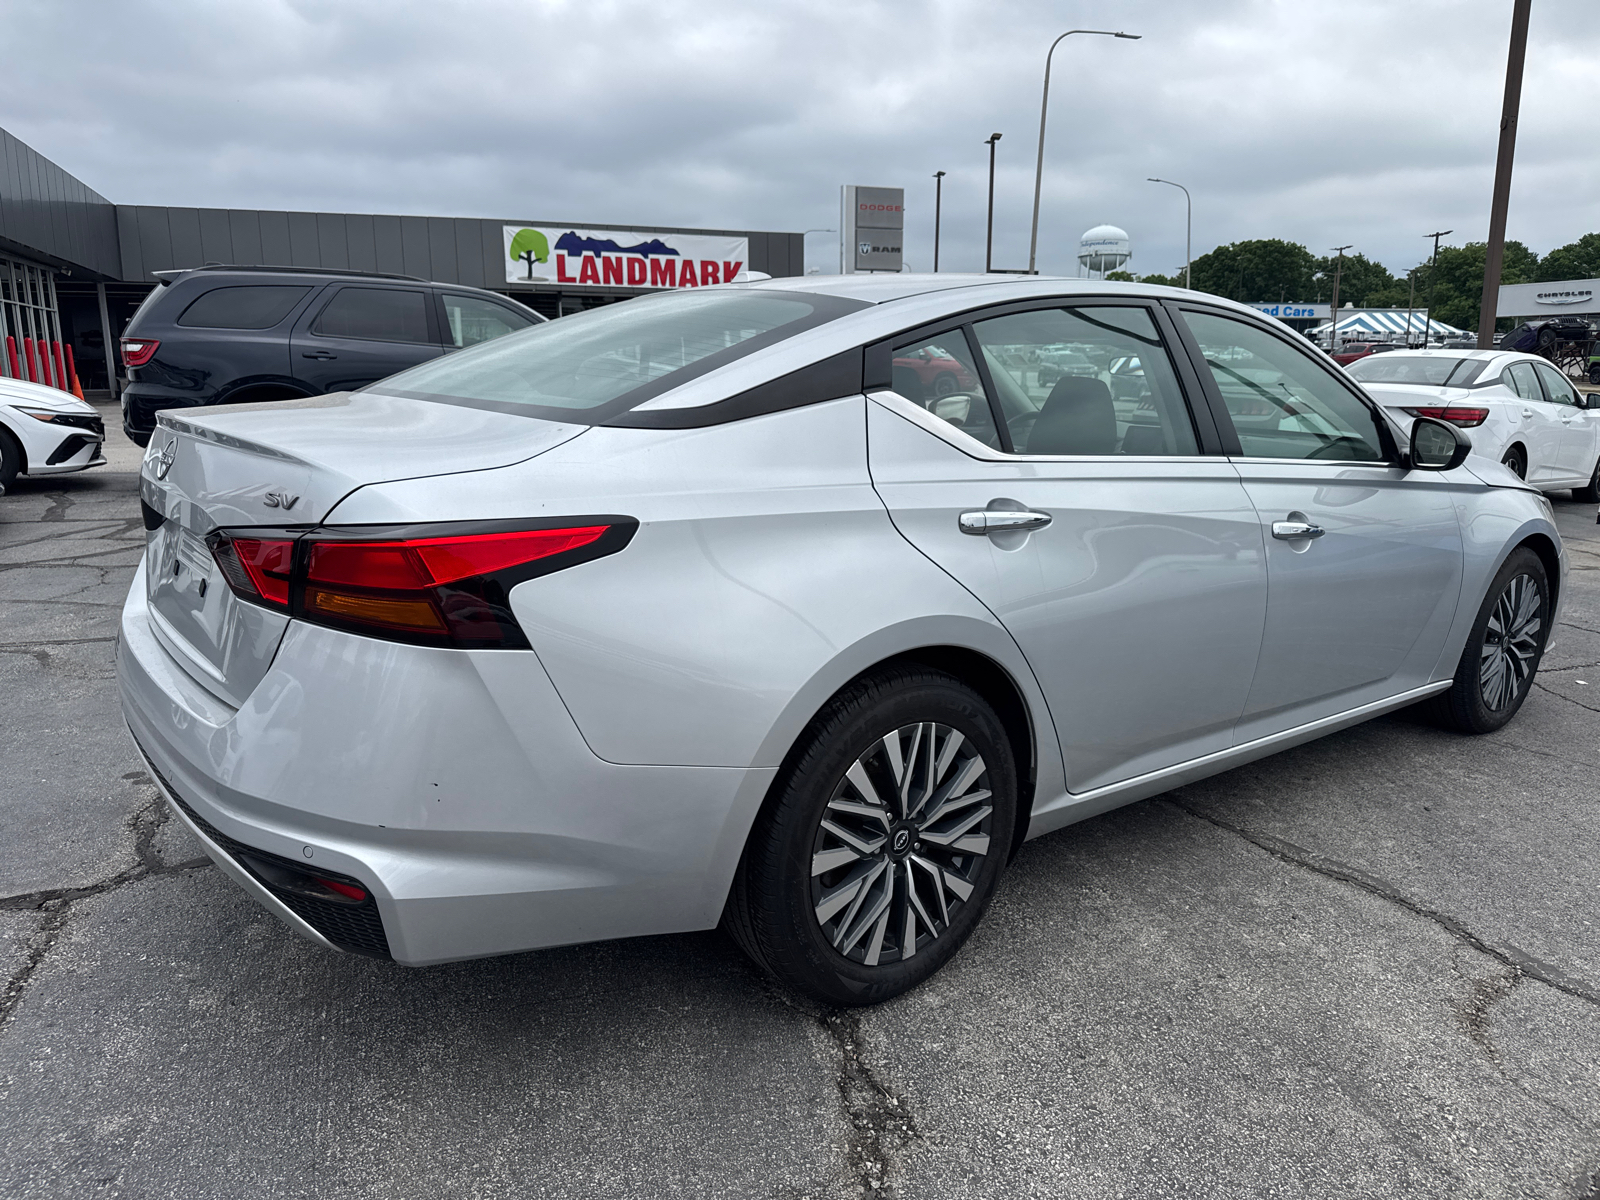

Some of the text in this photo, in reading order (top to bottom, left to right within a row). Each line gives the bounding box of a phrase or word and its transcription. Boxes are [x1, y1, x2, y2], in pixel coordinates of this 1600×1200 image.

[860, 203, 902, 212] DODGE
[556, 254, 742, 287] LANDMARK
[1537, 290, 1592, 298] CHRYSLER
[1250, 305, 1315, 316] ed Cars
[263, 492, 300, 511] SV
